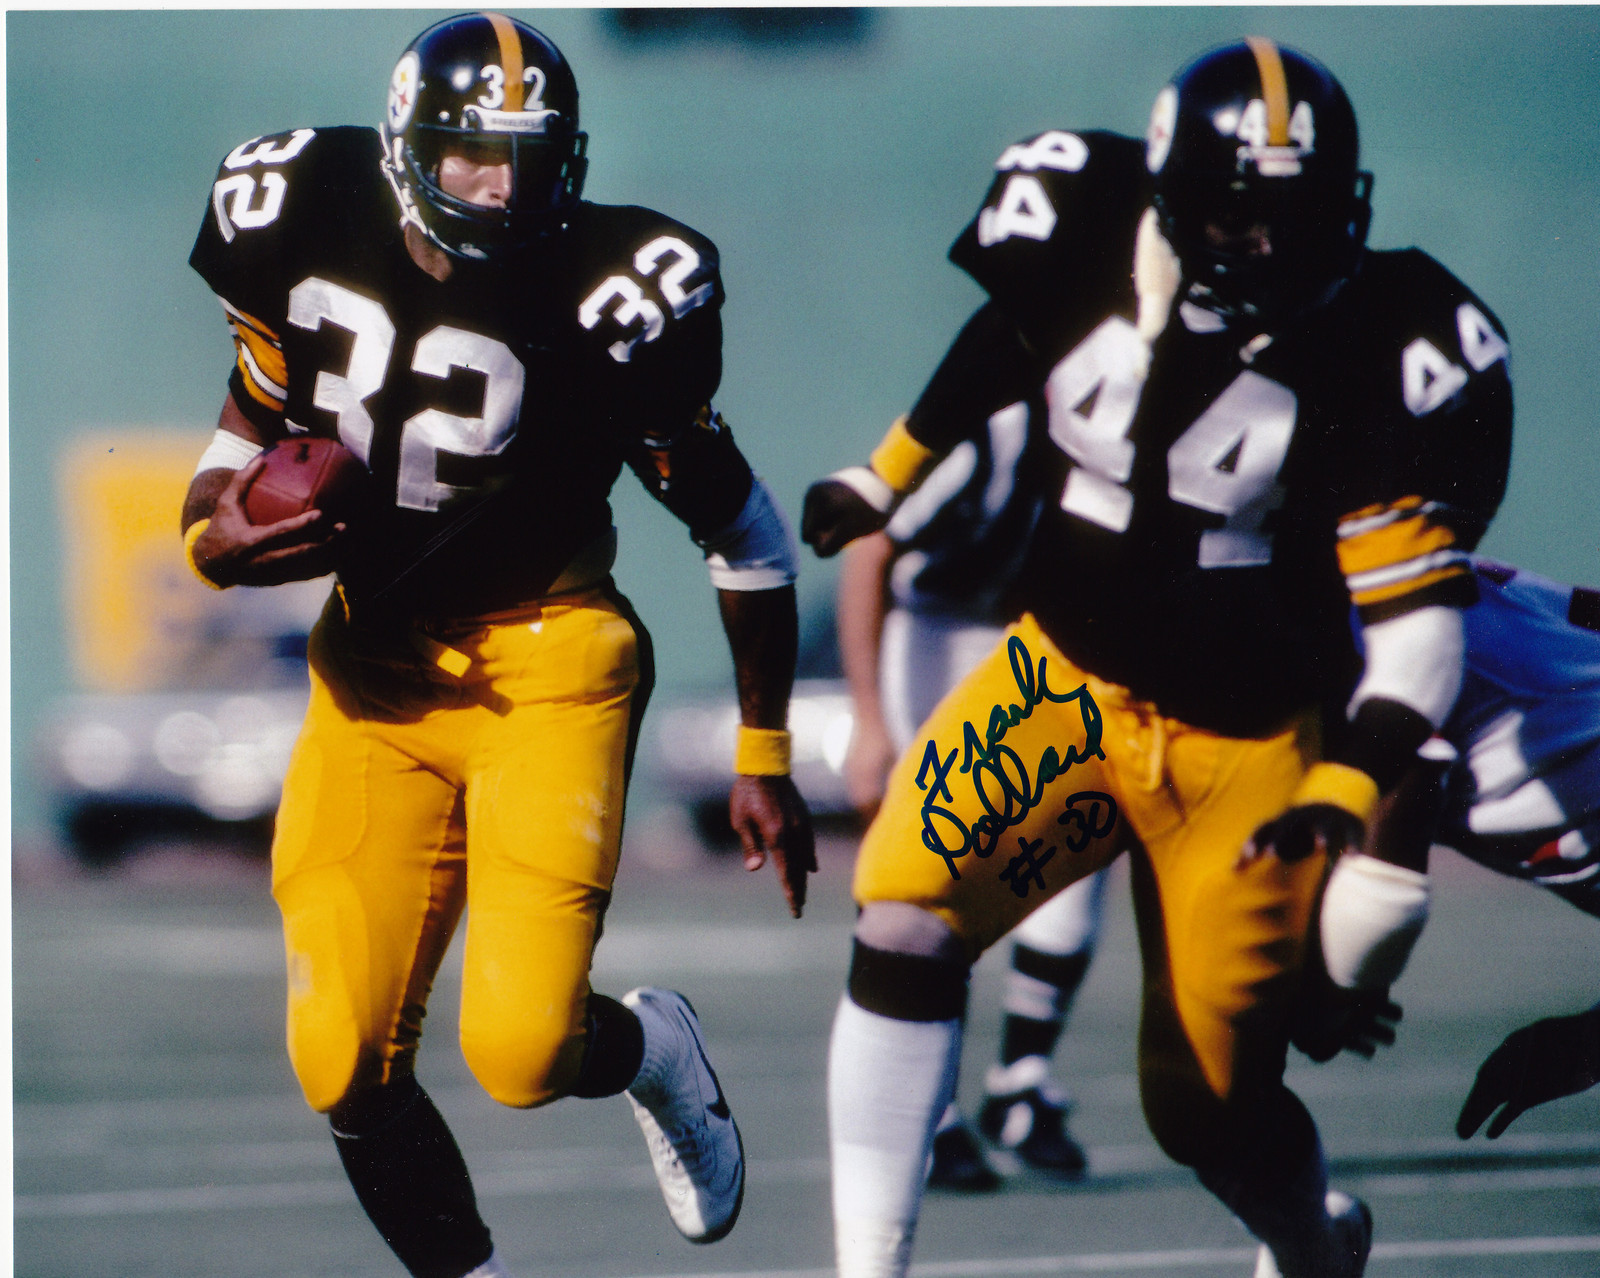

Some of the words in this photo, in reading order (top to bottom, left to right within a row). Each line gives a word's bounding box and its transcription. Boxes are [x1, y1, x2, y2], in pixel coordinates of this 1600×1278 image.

[477, 64, 547, 111] 32
[1236, 98, 1316, 154] 44
[213, 128, 317, 243] 32
[978, 130, 1090, 247] 44
[577, 235, 715, 363] 32
[287, 276, 526, 513] 32
[1402, 303, 1509, 417] 44
[1046, 315, 1298, 569] 44
